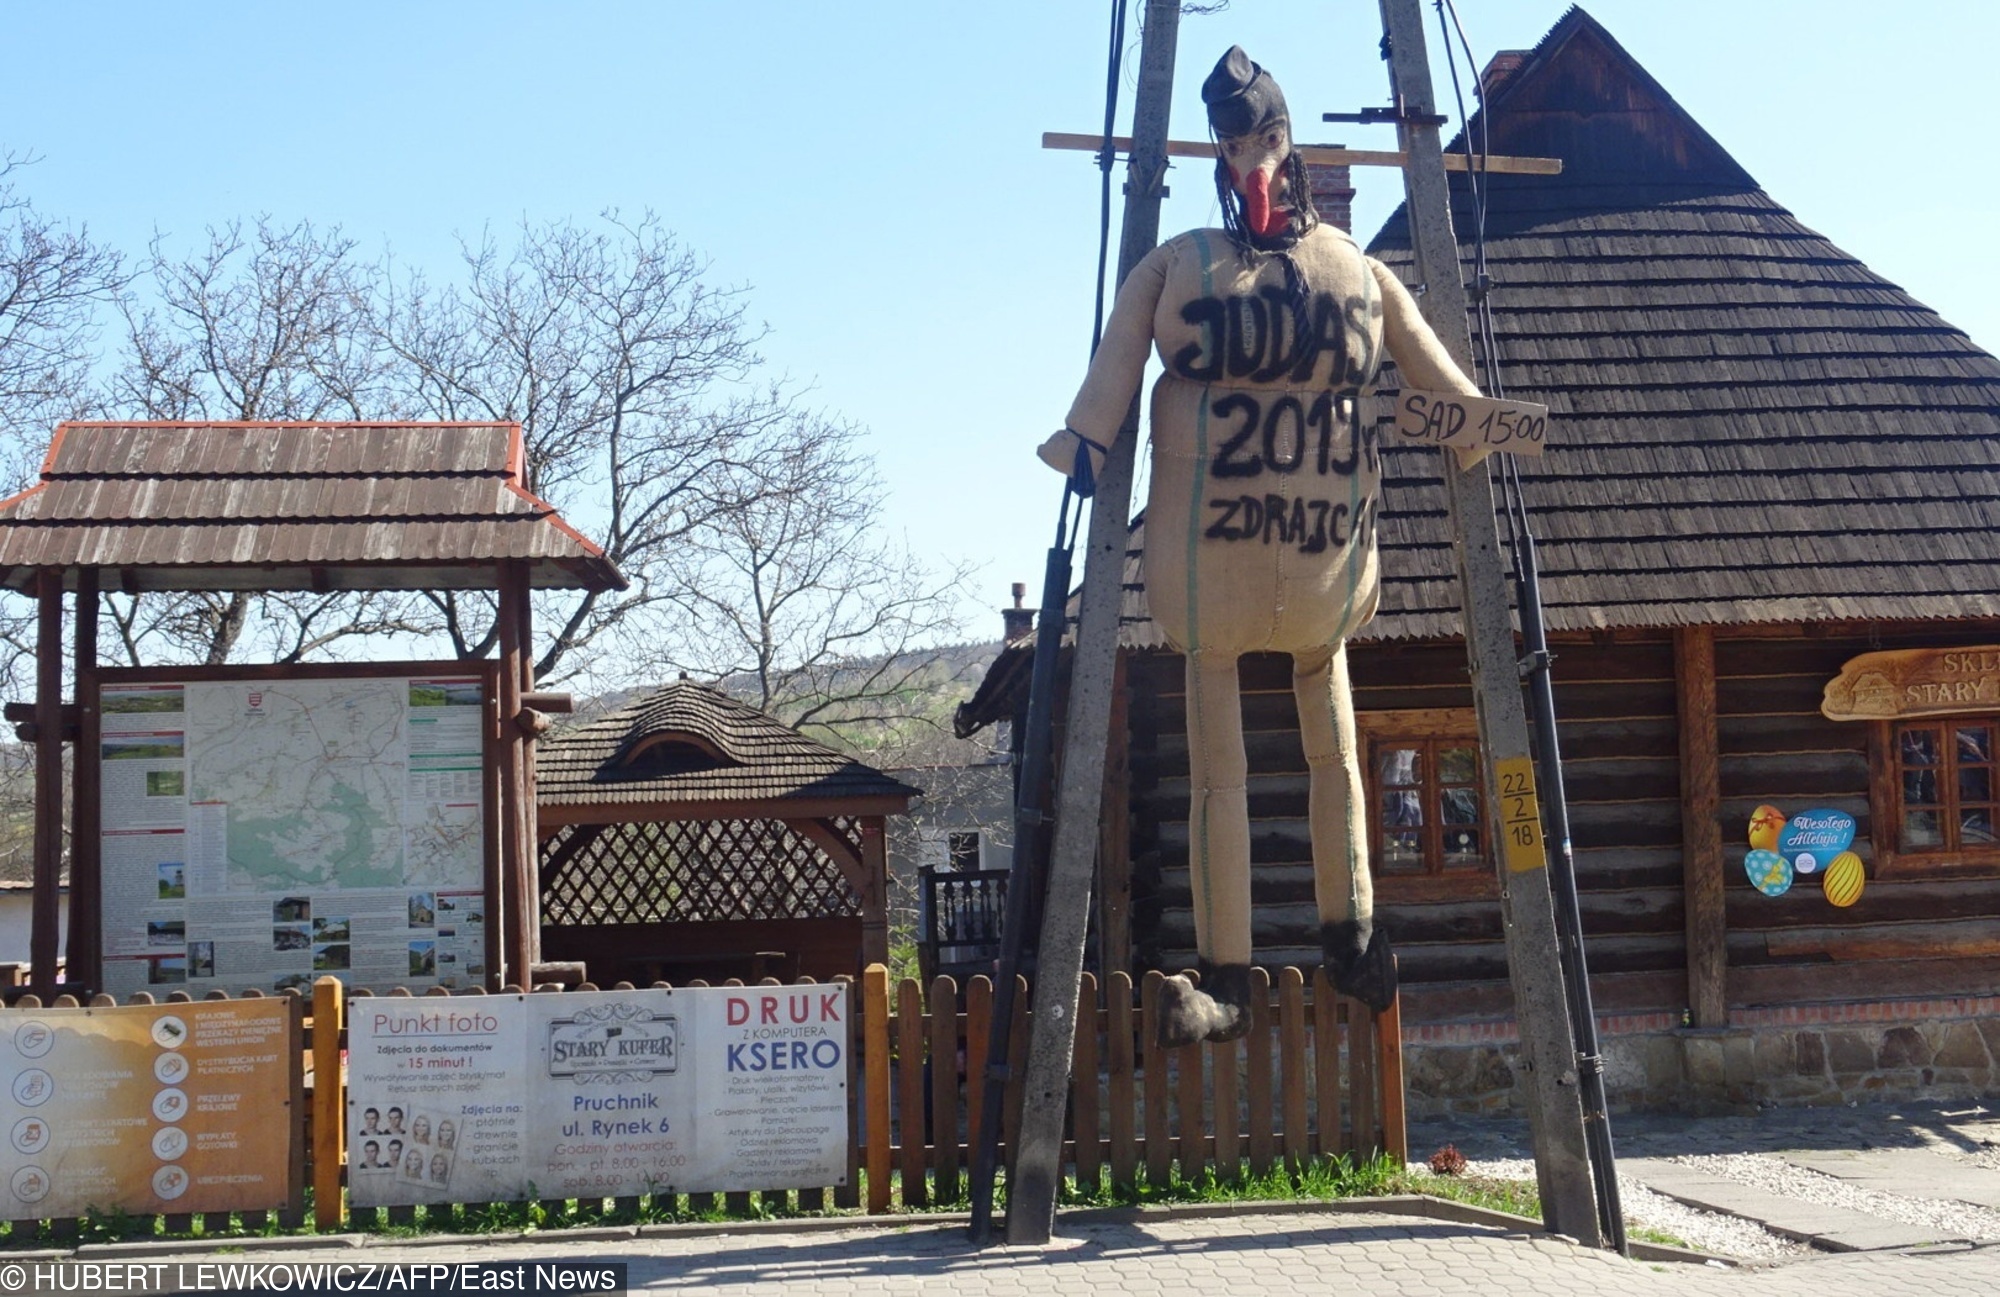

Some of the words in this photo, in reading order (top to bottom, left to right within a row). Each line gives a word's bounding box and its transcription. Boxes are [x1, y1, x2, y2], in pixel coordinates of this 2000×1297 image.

[1402, 395, 1466, 442] SAD
[1479, 410, 1545, 444] 15:00
[1944, 651, 2000, 673] SKL
[1906, 676, 1988, 703] STARY
[1503, 773, 1529, 793] 22
[1514, 797, 1527, 817] 2
[1793, 815, 1852, 832] Wesołego
[1512, 824, 1533, 846] 18
[1787, 831, 1838, 848] Alleluja
[727, 993, 841, 1026] DRUK
[374, 1013, 441, 1034] Punkt
[449, 1012, 498, 1033] foto
[743, 1029, 749, 1040] Z
[753, 1026, 827, 1040] KOMPUTERA
[377, 1045, 412, 1056] Zdjęcia
[415, 1044, 428, 1054] do
[430, 1042, 493, 1053] dokumentów
[552, 1038, 609, 1063] STARY
[618, 1036, 673, 1058] KUFER
[727, 1039, 841, 1072] KSERO
[408, 1058, 423, 1069] 15
[427, 1056, 465, 1069] minut
[461, 1105, 502, 1117] Zdjęcia
[505, 1104, 524, 1114] na:
[573, 1092, 660, 1112] Pruchnik
[562, 1120, 584, 1138] ul.
[592, 1118, 653, 1140] Rynek
[659, 1117, 670, 1134] 6
[554, 1142, 610, 1156] Godziny
[651, 1154, 686, 1168] 16.00
